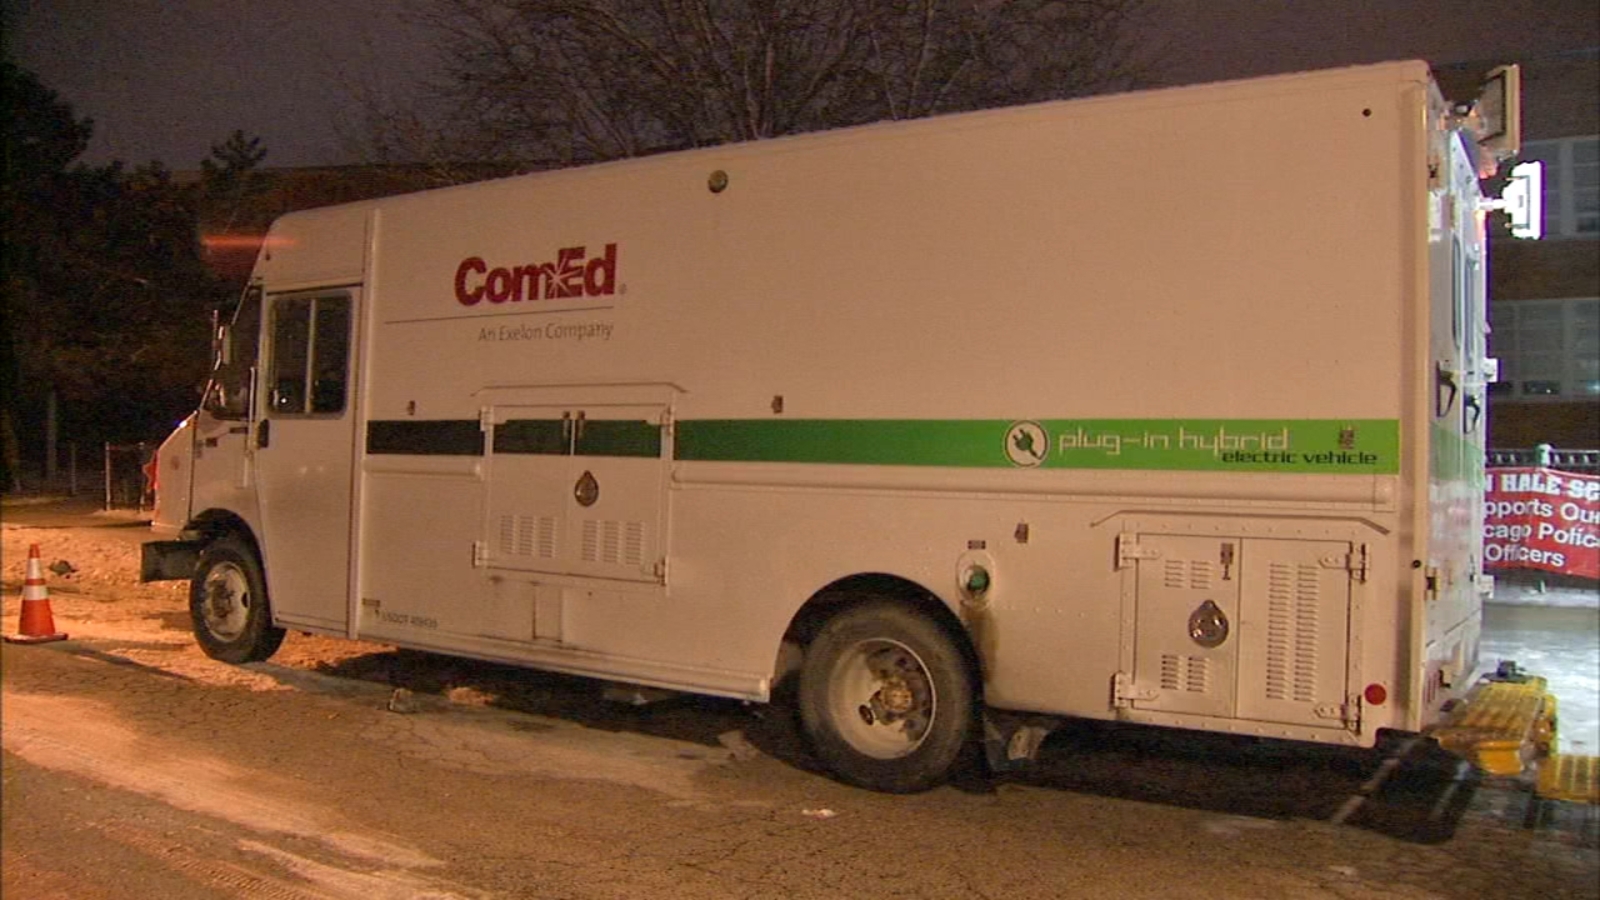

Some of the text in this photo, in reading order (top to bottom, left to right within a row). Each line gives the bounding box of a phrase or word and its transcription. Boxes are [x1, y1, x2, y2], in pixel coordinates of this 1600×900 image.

[454, 243, 617, 306] ComEd
[478, 321, 614, 341] An Exelon Company
[1059, 426, 1288, 457] plug-in hybrid
[1222, 450, 1378, 465] electric vehicle
[1502, 474, 1561, 495] HALE
[1539, 522, 1600, 547] Polic
